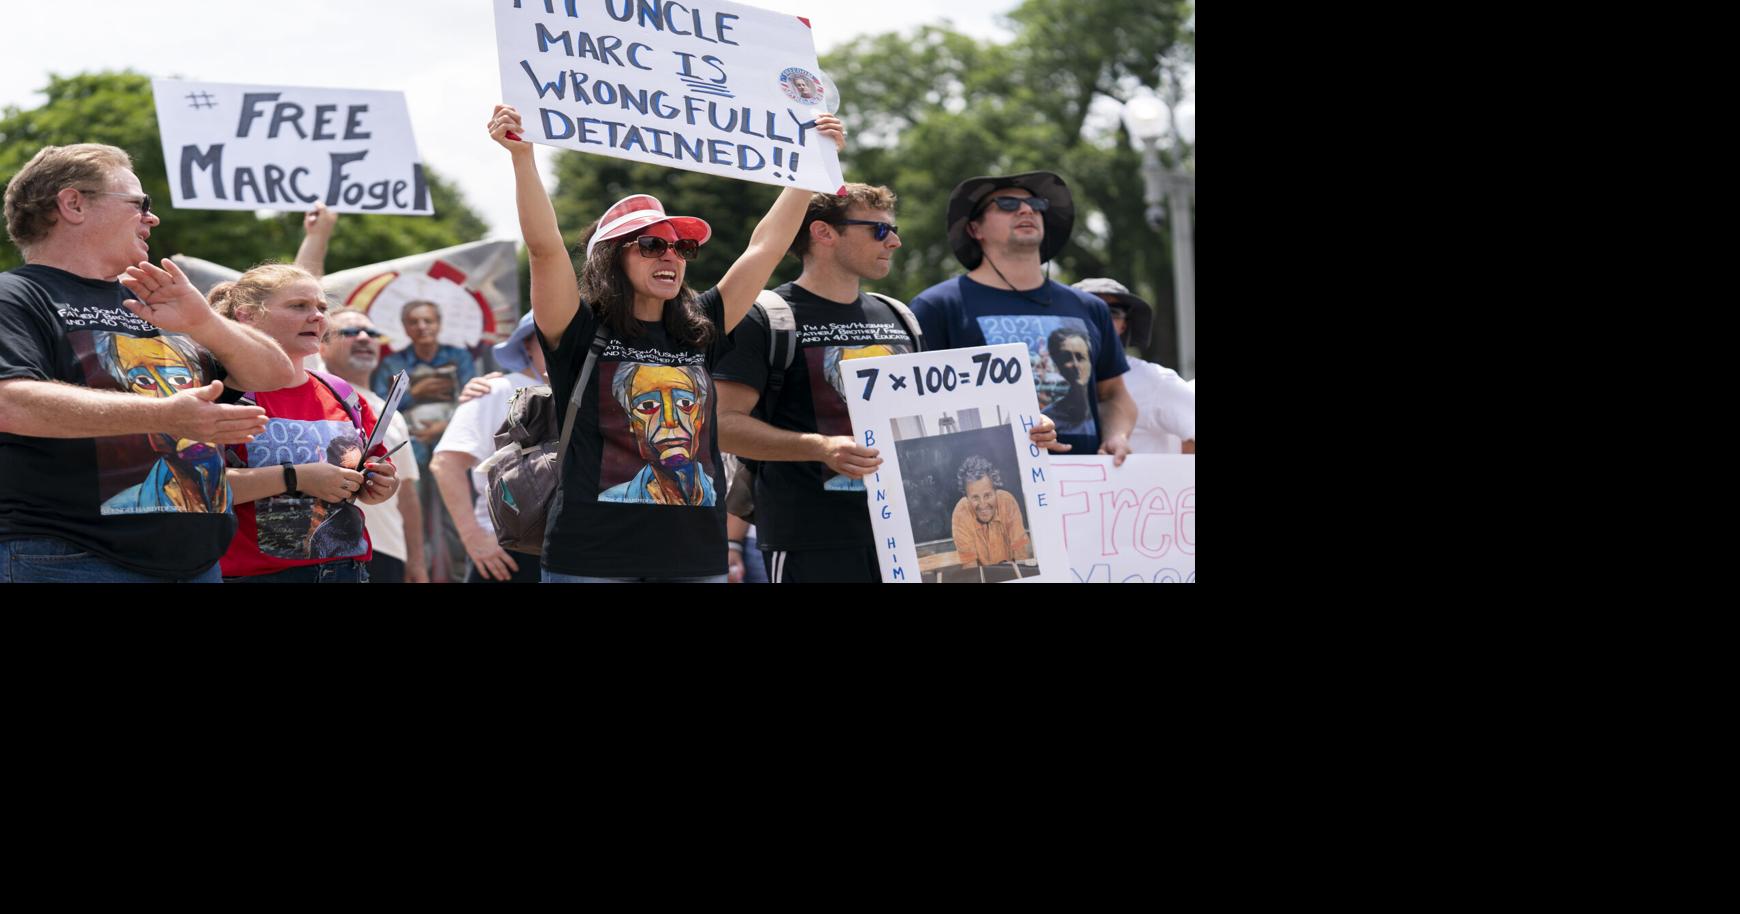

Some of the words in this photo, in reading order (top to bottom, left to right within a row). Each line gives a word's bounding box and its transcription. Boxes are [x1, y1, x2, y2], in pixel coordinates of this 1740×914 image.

[535, 23, 653, 70] MARC
[672, 51, 728, 85] IS
[606, 0, 739, 46] UNCLE
[236, 92, 371, 140] FREE
[520, 60, 818, 147] WRONGFULLY
[180, 143, 319, 204] MARC
[326, 150, 429, 211] Fogel
[539, 108, 800, 181] DETAINED!!
[856, 368, 879, 401] 7
[1019, 413, 1048, 507] HOME
[864, 430, 892, 520] BING
[887, 536, 905, 580] HIM
